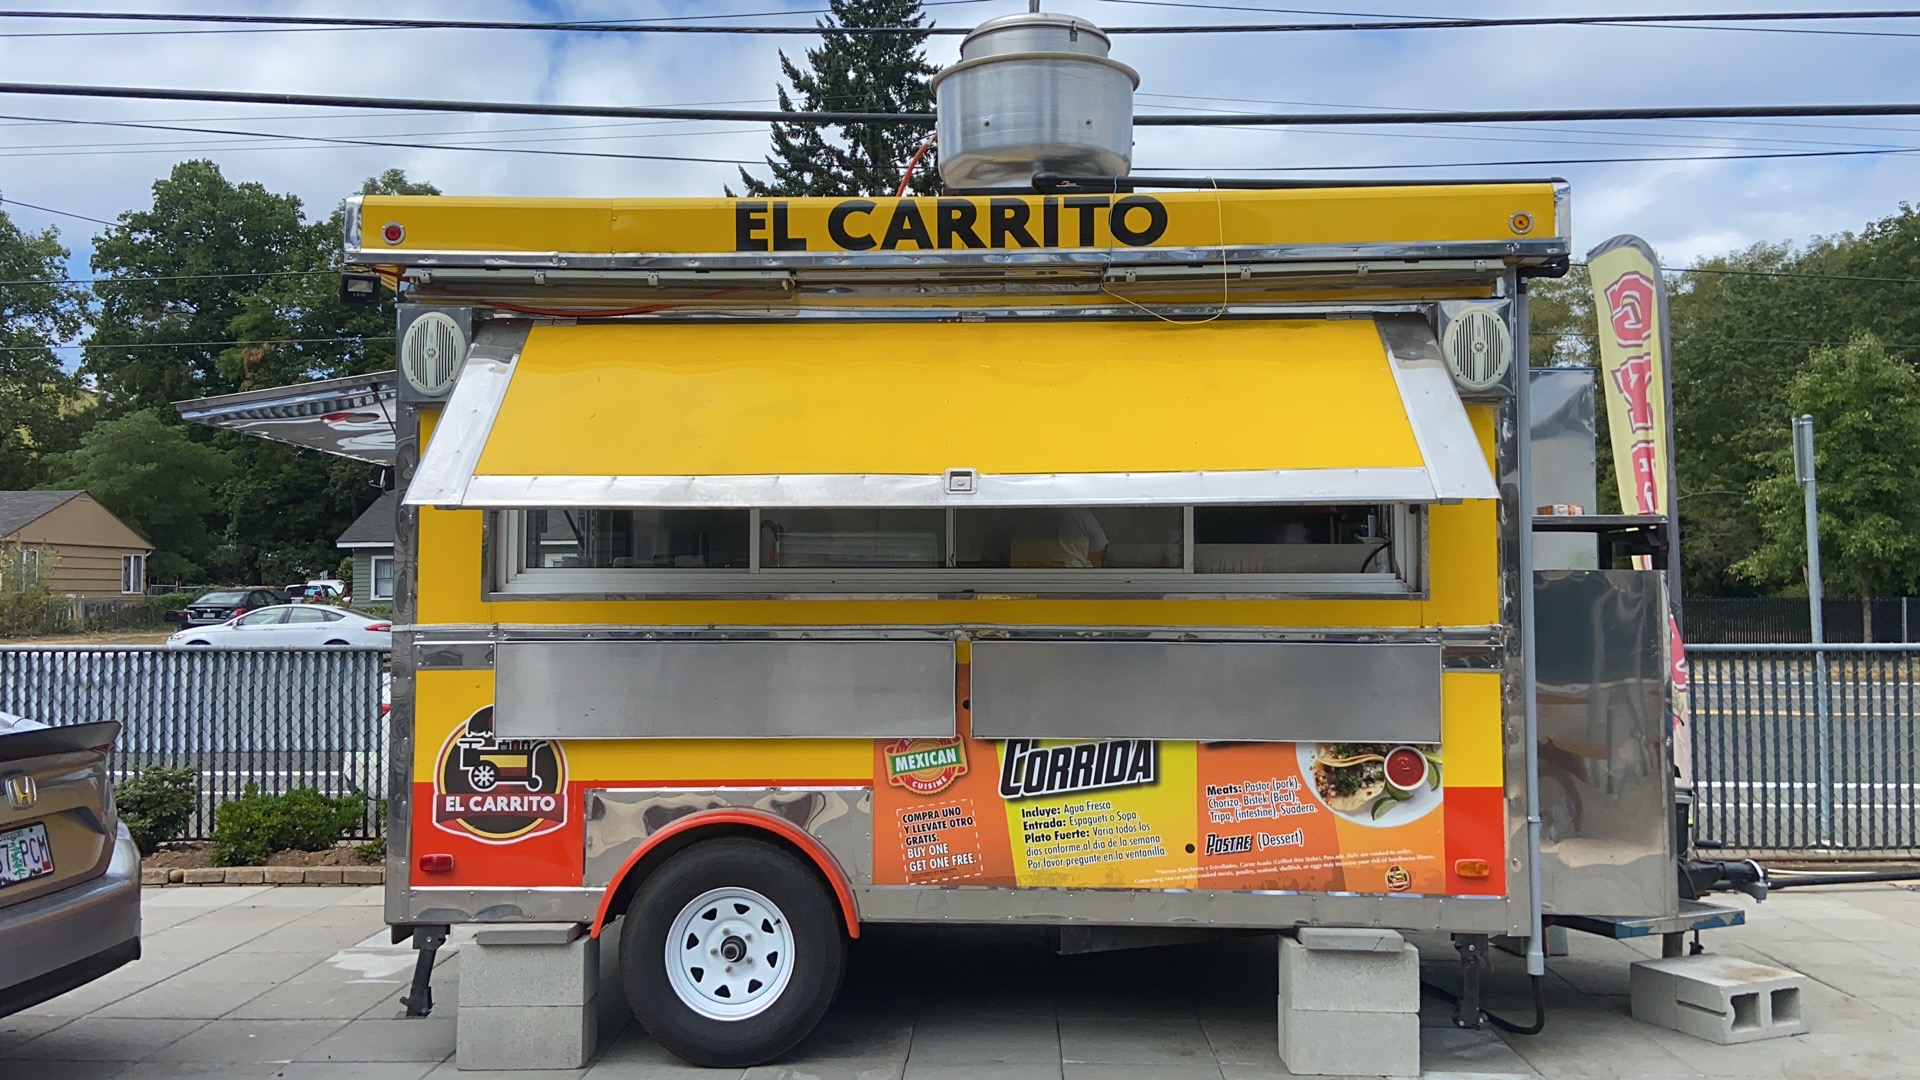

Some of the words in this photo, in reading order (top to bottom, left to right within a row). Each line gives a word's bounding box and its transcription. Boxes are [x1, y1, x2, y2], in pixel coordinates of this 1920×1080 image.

[736, 201, 806, 251] EL
[828, 195, 1168, 250] CARRITO
[895, 748, 957, 772] MEXICAN
[1000, 740, 1154, 797] CORRIDA
[911, 775, 948, 790] CUISINE
[1207, 784, 1242, 796] Meats:
[1245, 781, 1270, 792] Pastor
[1272, 777, 1301, 791] (pork),
[445, 796, 464, 811] EL
[469, 796, 556, 811] CARRITO
[1021, 806, 1060, 818] Incluye:
[1064, 804, 1084, 816] Agua
[1086, 800, 1114, 811] Fresca.
[1208, 798, 1242, 809] Chorizo,
[1244, 794, 1268, 806] Bistek
[902, 810, 940, 823] COMPRA
[942, 807, 961, 817] UNO
[1023, 817, 1066, 831] Entrada:
[1069, 813, 1108, 828] Espagueti
[1110, 814, 1115, 822] o
[1116, 811, 1140, 823] Sopa.
[1210, 812, 1234, 822] Tripa,
[1236, 806, 1279, 821] (intestine),
[1281, 804, 1318, 815] Suadero.
[904, 826, 909, 835] Y
[912, 820, 947, 833] LLEVATE
[949, 817, 973, 827] OTRO
[1024, 832, 1051, 843] Plato
[1054, 828, 1090, 841] Fuerte:
[1116, 823, 1136, 834] todos
[1138, 821, 1150, 832] los
[906, 833, 940, 846] GRATIS.
[1044, 842, 1081, 855] conforme
[1083, 840, 1090, 850] al
[1108, 837, 1118, 848] de
[1120, 836, 1128, 847] la
[1130, 834, 1162, 846] semana.
[1206, 834, 1251, 854] POSTRE
[1257, 828, 1303, 849] (Dessert)
[19, 835, 50, 867] PCM
[907, 846, 926, 859] BUY
[929, 843, 949, 855] ONE
[1028, 860, 1041, 870] Por
[1043, 858, 1063, 868] favor
[1066, 854, 1102, 868] pregunte
[1104, 852, 1114, 862] en
[1116, 850, 1124, 860] la
[1126, 846, 1168, 859] ventanilla.
[909, 859, 926, 872] GET
[929, 856, 949, 868] ONE
[952, 853, 977, 866] FREE.
